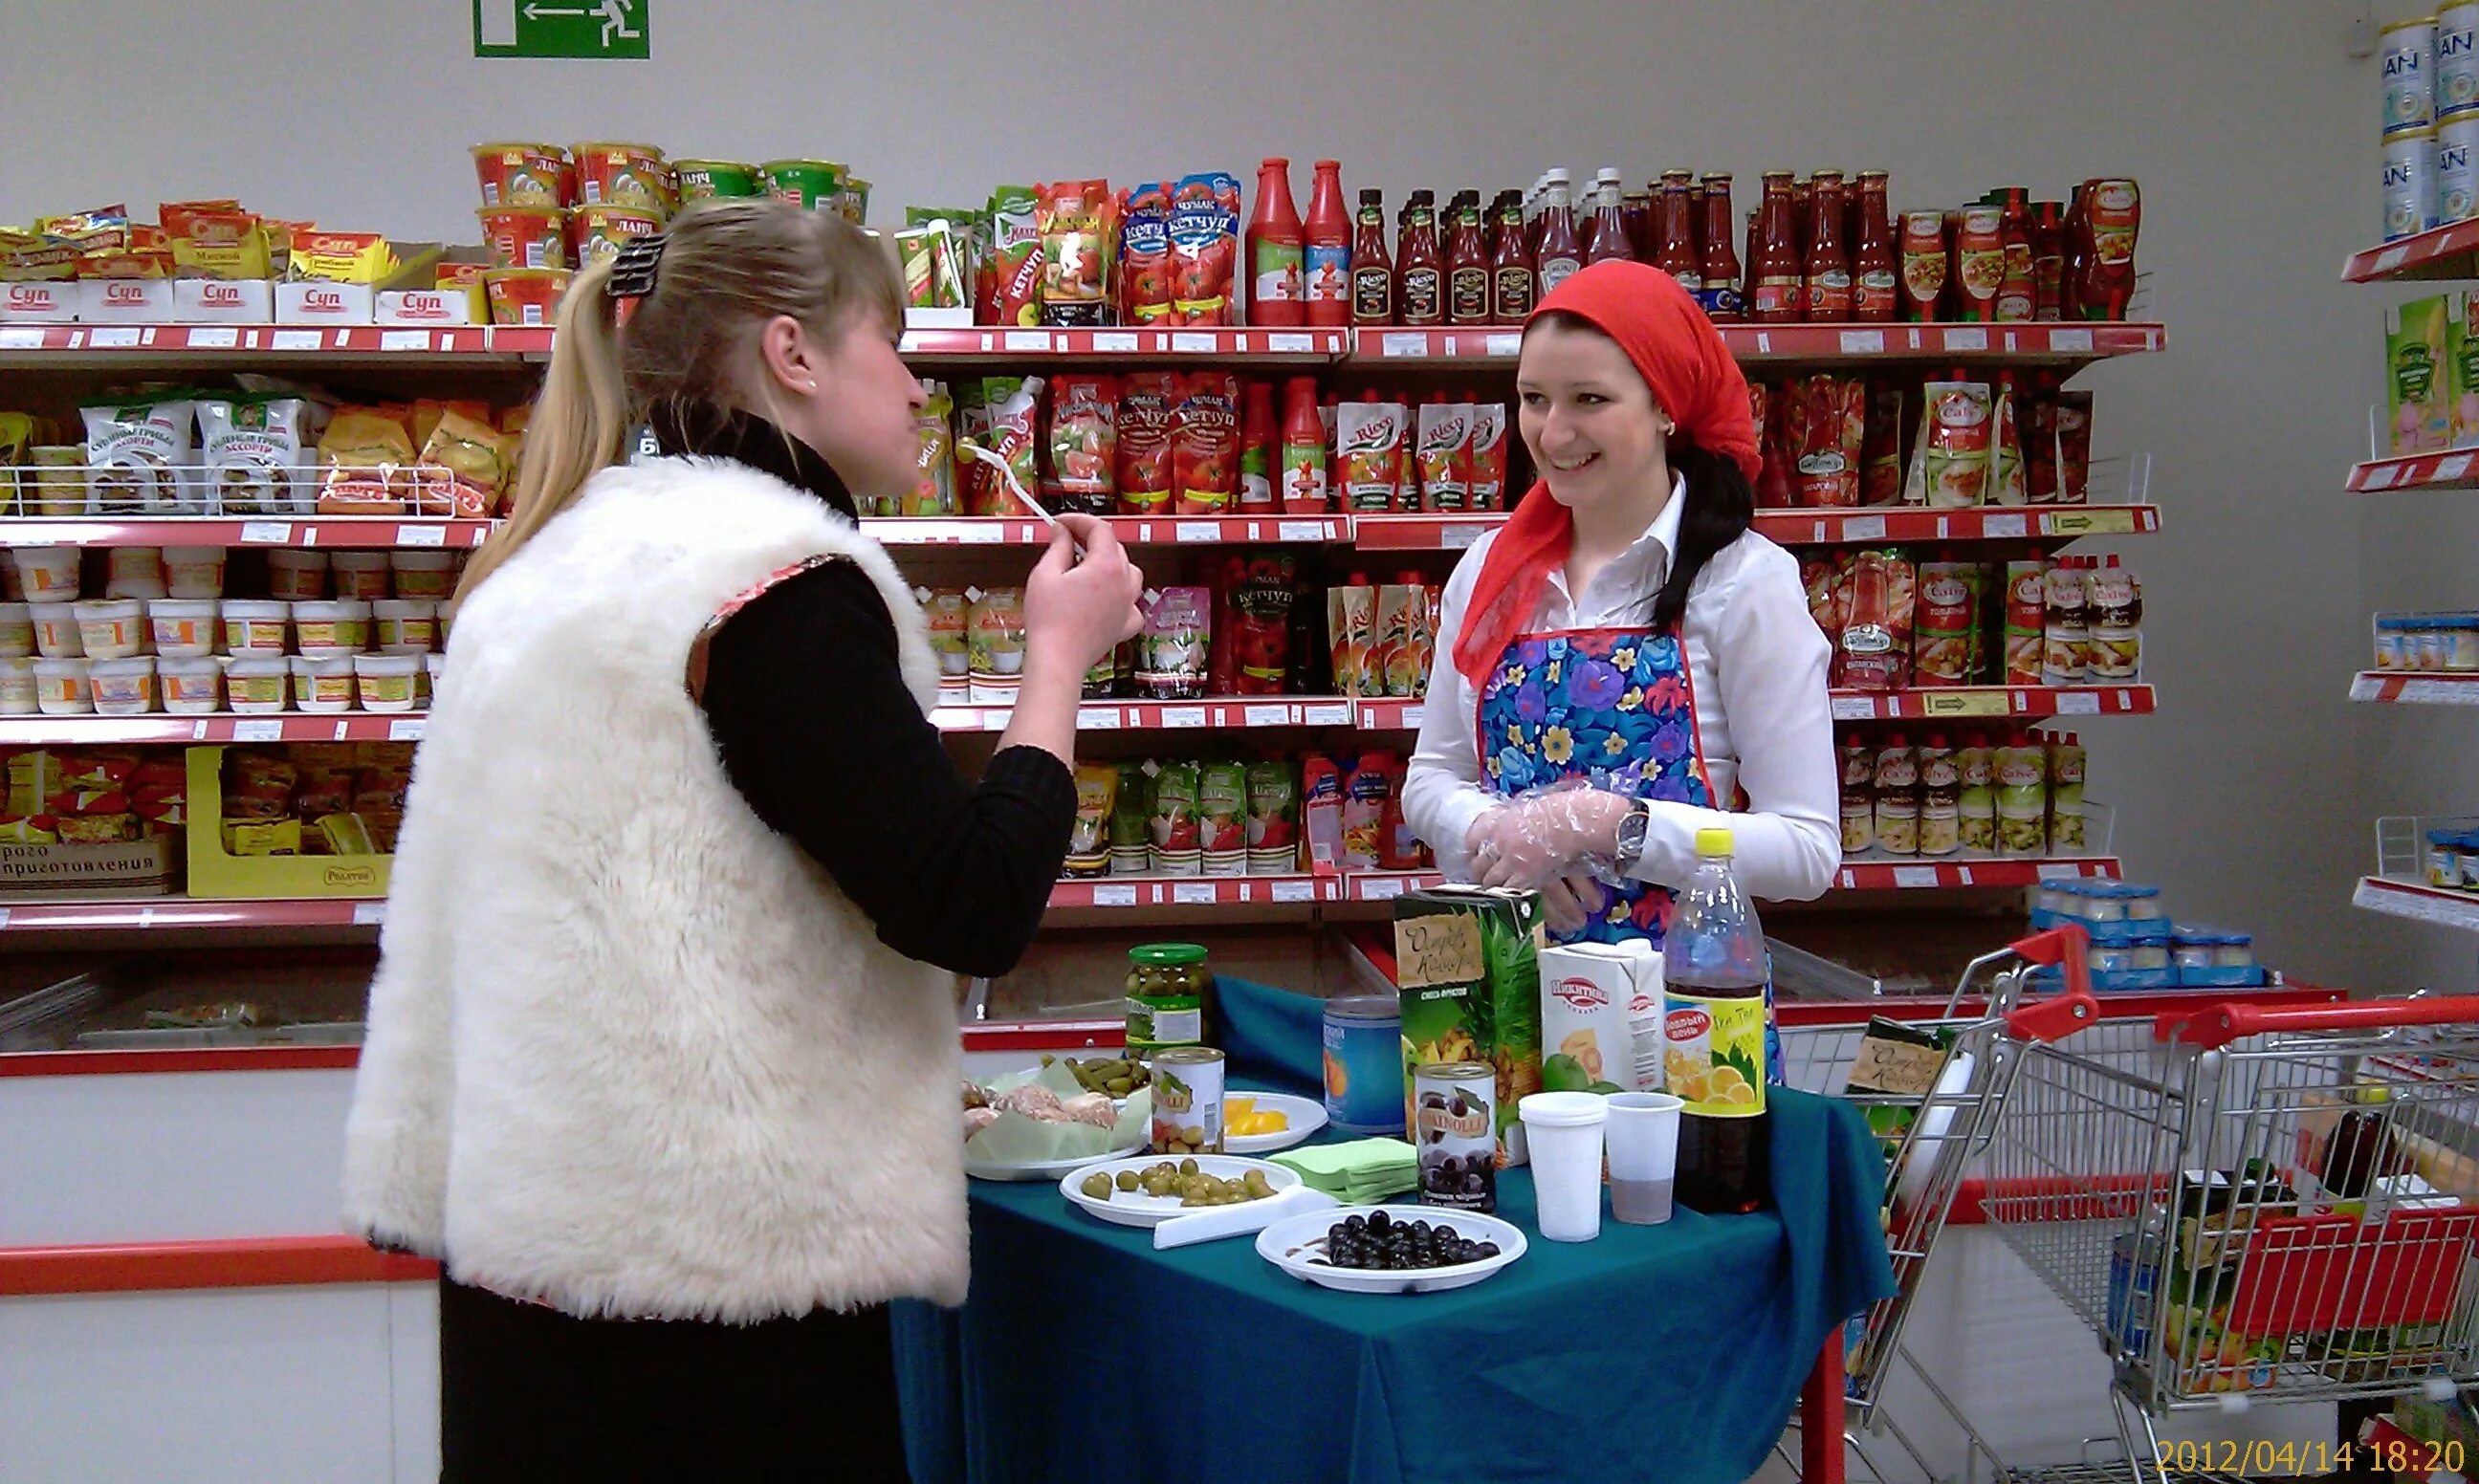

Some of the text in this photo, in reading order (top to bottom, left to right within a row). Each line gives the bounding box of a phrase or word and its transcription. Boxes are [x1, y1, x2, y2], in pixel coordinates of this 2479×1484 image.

[1010, 249, 1044, 298] КЕТЧУП
[9, 285, 50, 305] Суп
[106, 283, 143, 301] Суп
[203, 283, 239, 301] Суп
[304, 289, 340, 307] Суп
[402, 292, 442, 312] Суп
[1355, 415, 1393, 442] Ricco
[225, 443, 274, 453] АССОРТИ
[2, 857, 153, 877] приготовления
